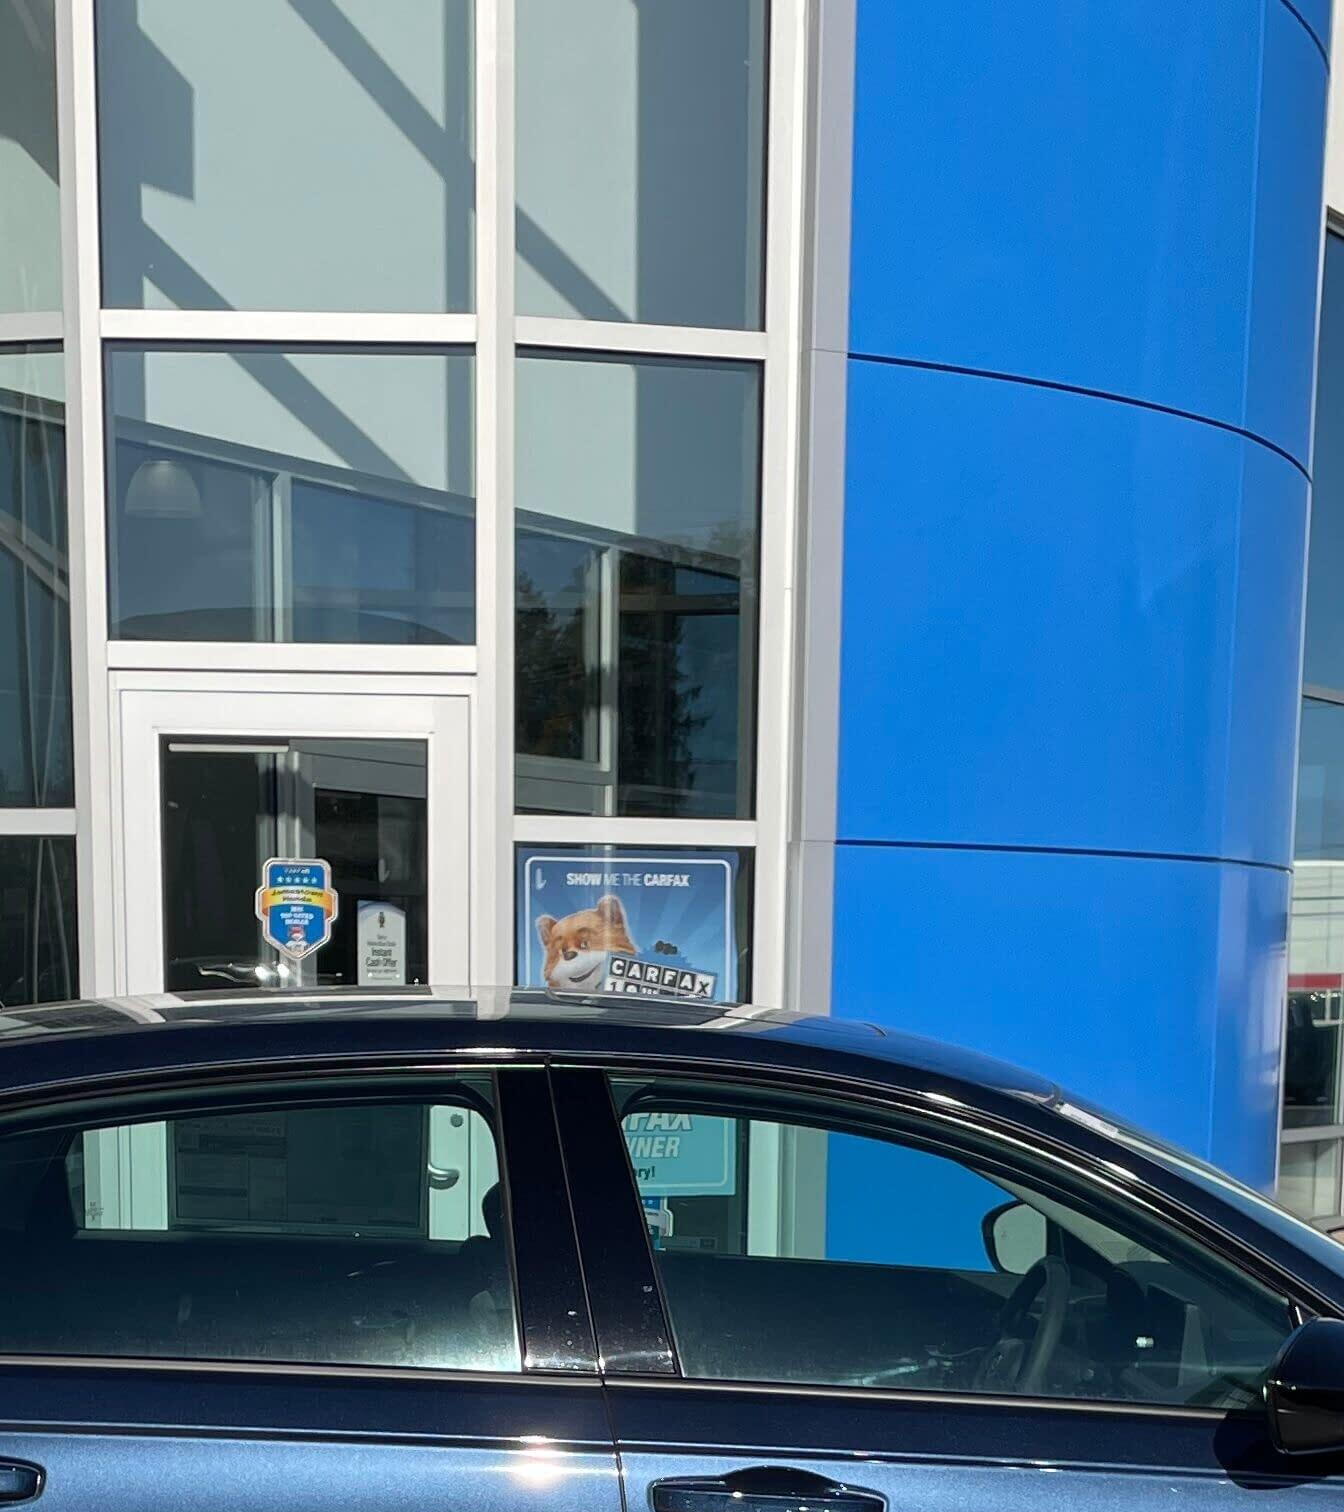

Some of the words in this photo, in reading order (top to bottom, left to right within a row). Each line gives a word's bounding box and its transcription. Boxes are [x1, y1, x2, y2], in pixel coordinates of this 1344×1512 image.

[567, 872, 601, 887] SHOW
[623, 873, 642, 887] THE
[643, 873, 690, 887] CARFAX
[610, 958, 711, 995] CARFAX
[621, 1113, 692, 1131] FAX
